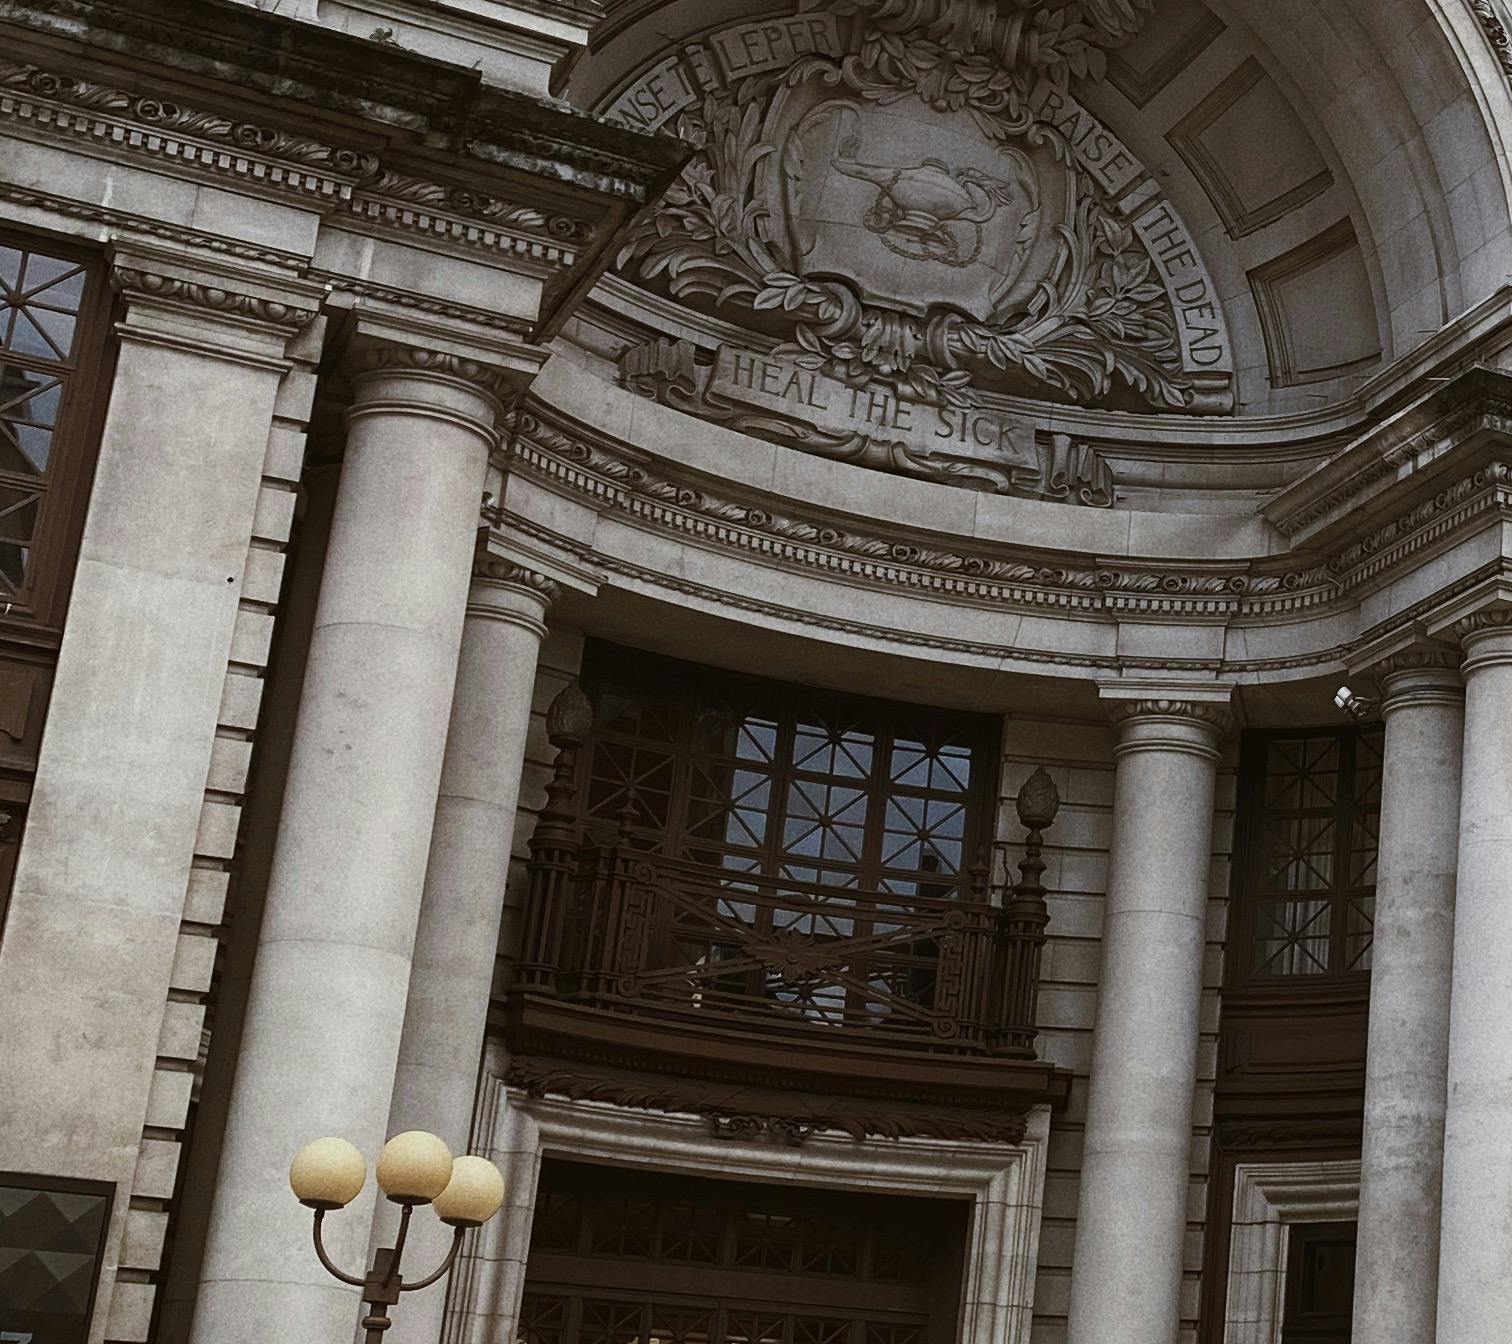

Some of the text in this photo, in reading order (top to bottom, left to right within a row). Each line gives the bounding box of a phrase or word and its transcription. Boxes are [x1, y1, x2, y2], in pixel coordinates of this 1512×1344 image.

[1040, 92, 1223, 368] RAISE THE DEAD
[732, 354, 1021, 455] HEAL THE SICK
